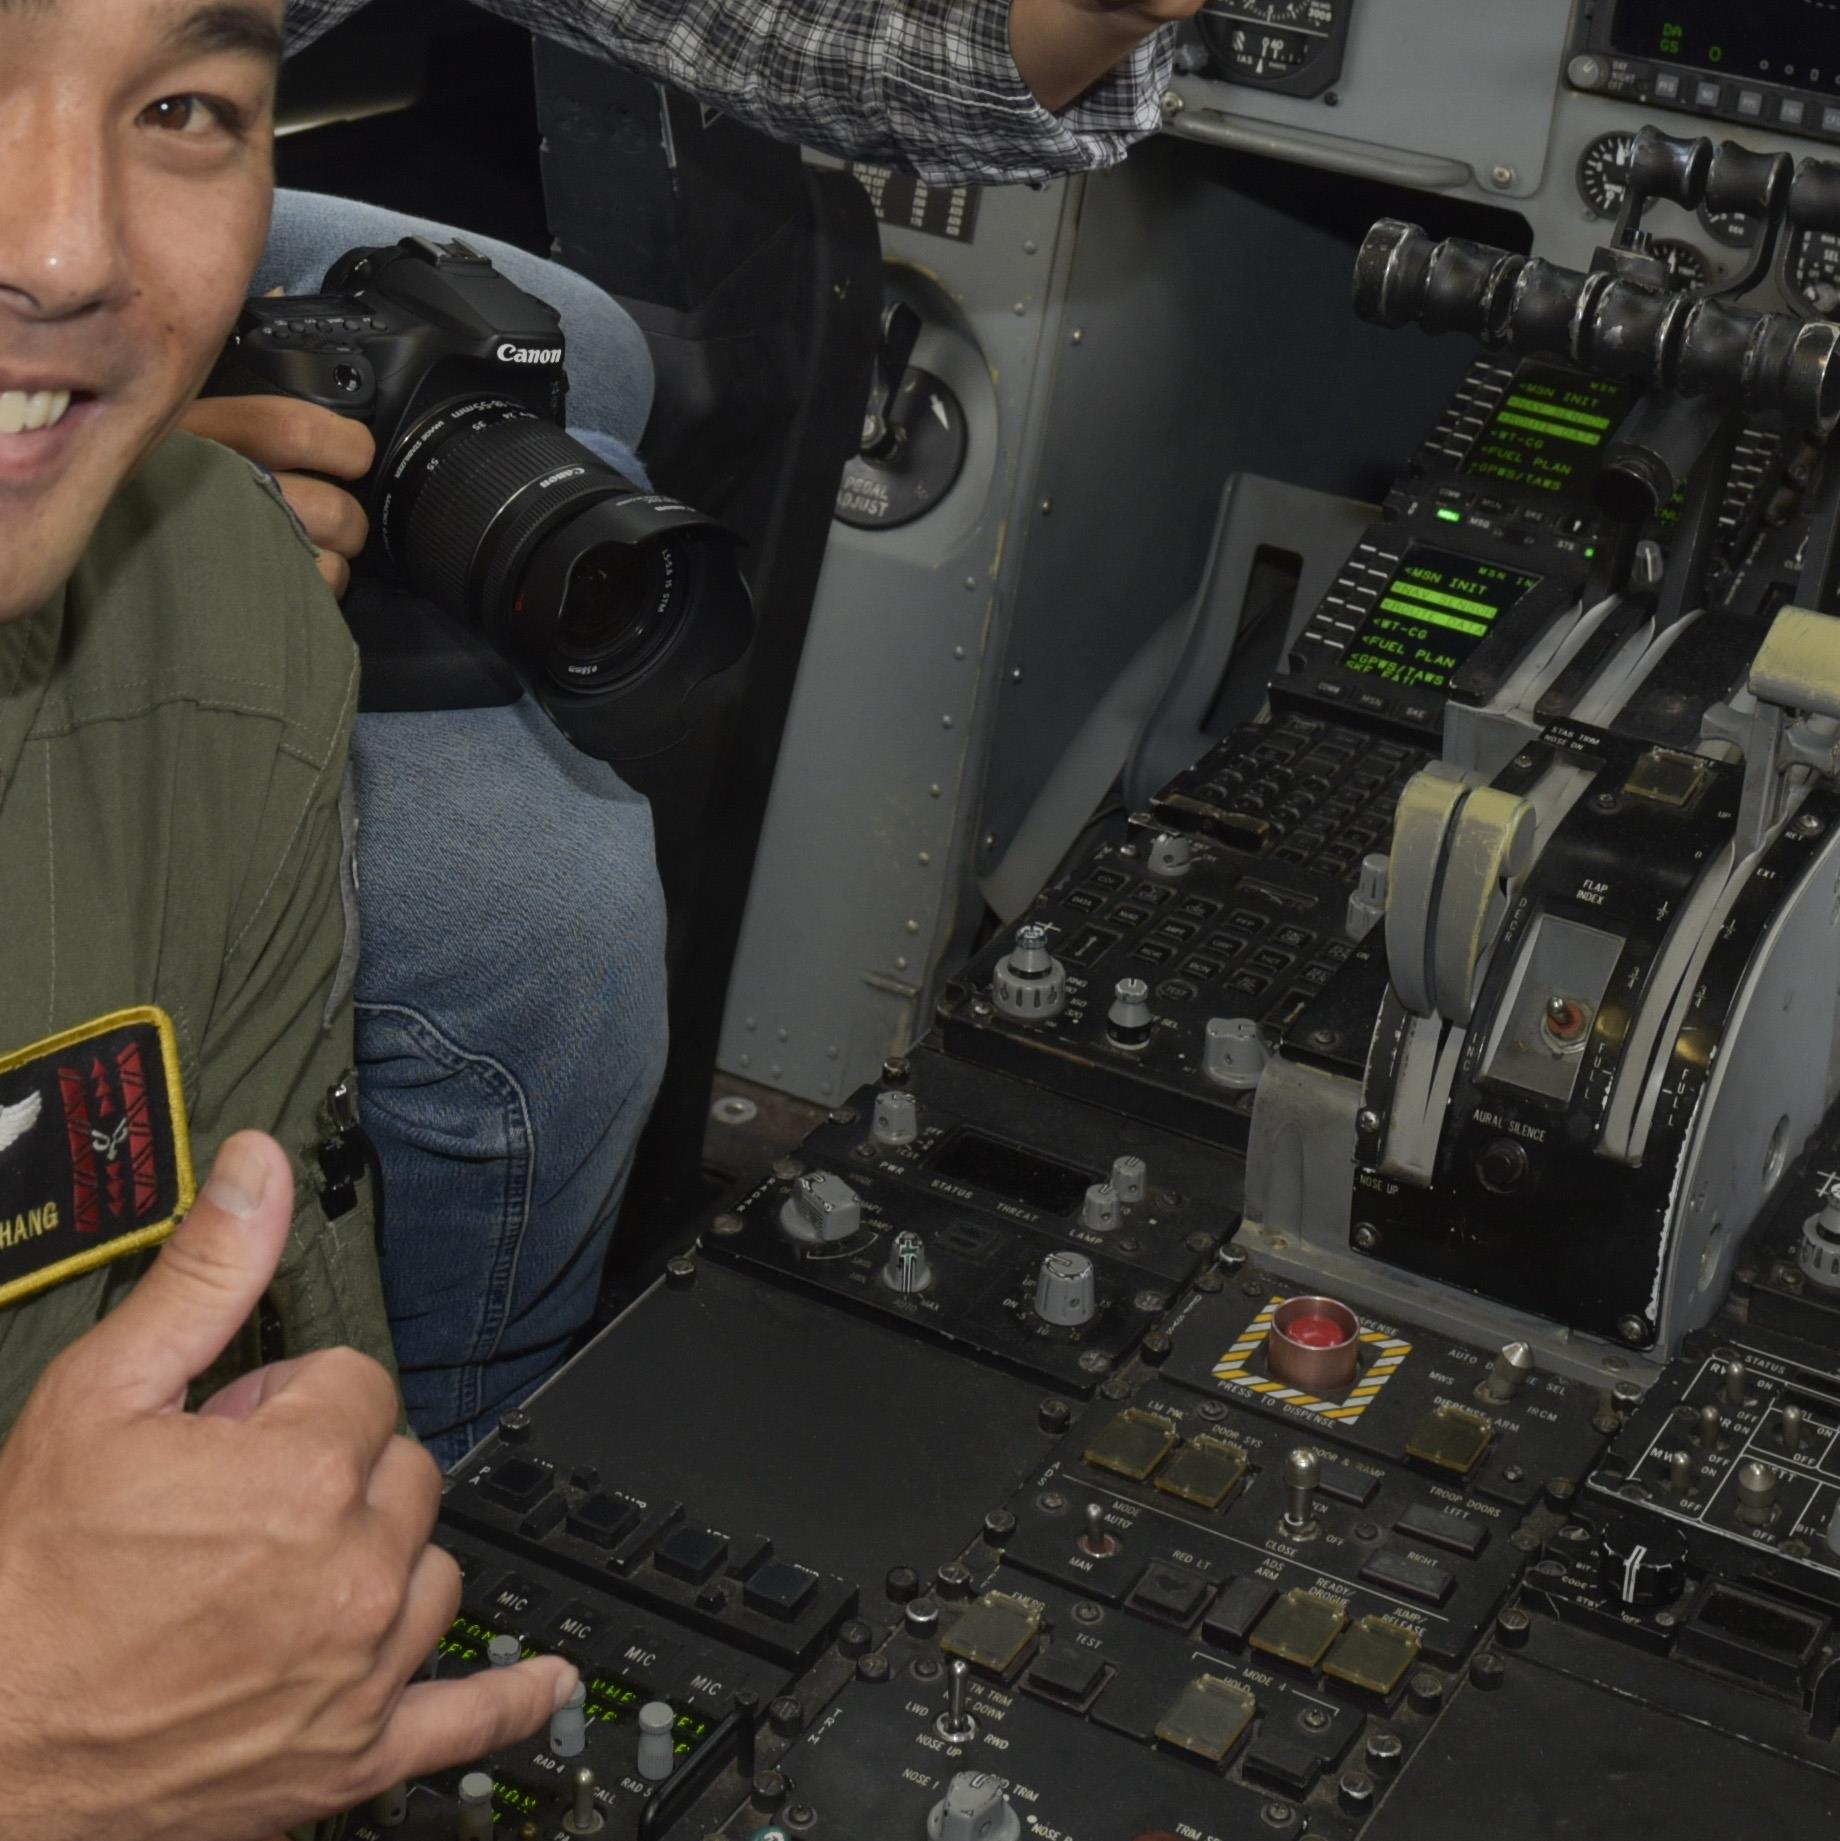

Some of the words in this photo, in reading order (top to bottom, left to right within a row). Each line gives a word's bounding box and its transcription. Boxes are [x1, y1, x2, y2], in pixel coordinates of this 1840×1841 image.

[496, 343, 562, 365] Canon
[539, 467, 585, 489] Canon
[1449, 577, 1488, 595] INIT
[1414, 648, 1456, 668] PLAN
[1582, 878, 1609, 894] FLAP
[1575, 889, 1606, 905] INDEX
[1472, 1108, 1504, 1129] AURAL
[1508, 1117, 1547, 1143] SILENCE
[879, 1160, 905, 1176] PWR
[930, 1178, 974, 1200] STATUS
[1359, 1175, 1383, 1192] NOSE
[1386, 1183, 1399, 1196] UP
[996, 1202, 1039, 1223] THREAT
[1068, 1229, 1103, 1246] LAMP
[1447, 1348, 1478, 1365] AUTO
[1744, 1355, 1786, 1375] STATUS
[1428, 1370, 1456, 1386] MWS
[1546, 1382, 1567, 1397] SEL
[1216, 1379, 1253, 1398] PRESS
[1259, 1397, 1276, 1406] TO
[1282, 1404, 1336, 1429] DISPENSE
[1527, 1406, 1558, 1422] IRCM
[1708, 1454, 1731, 1467] OFF
[1793, 1453, 1816, 1466] OFF
[1428, 1486, 1463, 1510] TROOP
[1465, 1498, 1502, 1518] DOORS
[1680, 1499, 1702, 1512] OFF
[1103, 1513, 1134, 1529] AUTO
[1442, 1505, 1469, 1520] LEFT
[1752, 1529, 1776, 1542] OFF
[1264, 1540, 1298, 1557] CLOSE
[1068, 1557, 1094, 1571] MAN
[1171, 1550, 1193, 1563] RED
[1196, 1559, 1211, 1570] LT
[1262, 1559, 1285, 1571] ADS
[1407, 1551, 1439, 1568] RIGHT
[1254, 1568, 1279, 1581] ARM
[1308, 1586, 1350, 1606] DROGUE
[1314, 1577, 1357, 1598] READY/
[497, 1591, 529, 1612] MIC
[1392, 1607, 1428, 1625] JUMP/
[561, 1618, 592, 1640] MIC
[1381, 1614, 1428, 1637] RELEASE
[1075, 1633, 1103, 1649] TEST
[624, 1646, 657, 1667] MIC
[690, 1675, 723, 1696] MIC
[1242, 1668, 1275, 1687] MODE
[1278, 1682, 1287, 1692] 4
[982, 1686, 1012, 1707] TRIM
[905, 1701, 929, 1717] LWD
[972, 1701, 1006, 1720] DOWN
[916, 1733, 942, 1752] NOSE
[946, 1746, 962, 1758] UP
[983, 1734, 1009, 1750] RWD
[902, 1768, 929, 1788] NOSE
[1012, 1782, 1039, 1802] TRIM
[1174, 1823, 1201, 1839] TRIM
